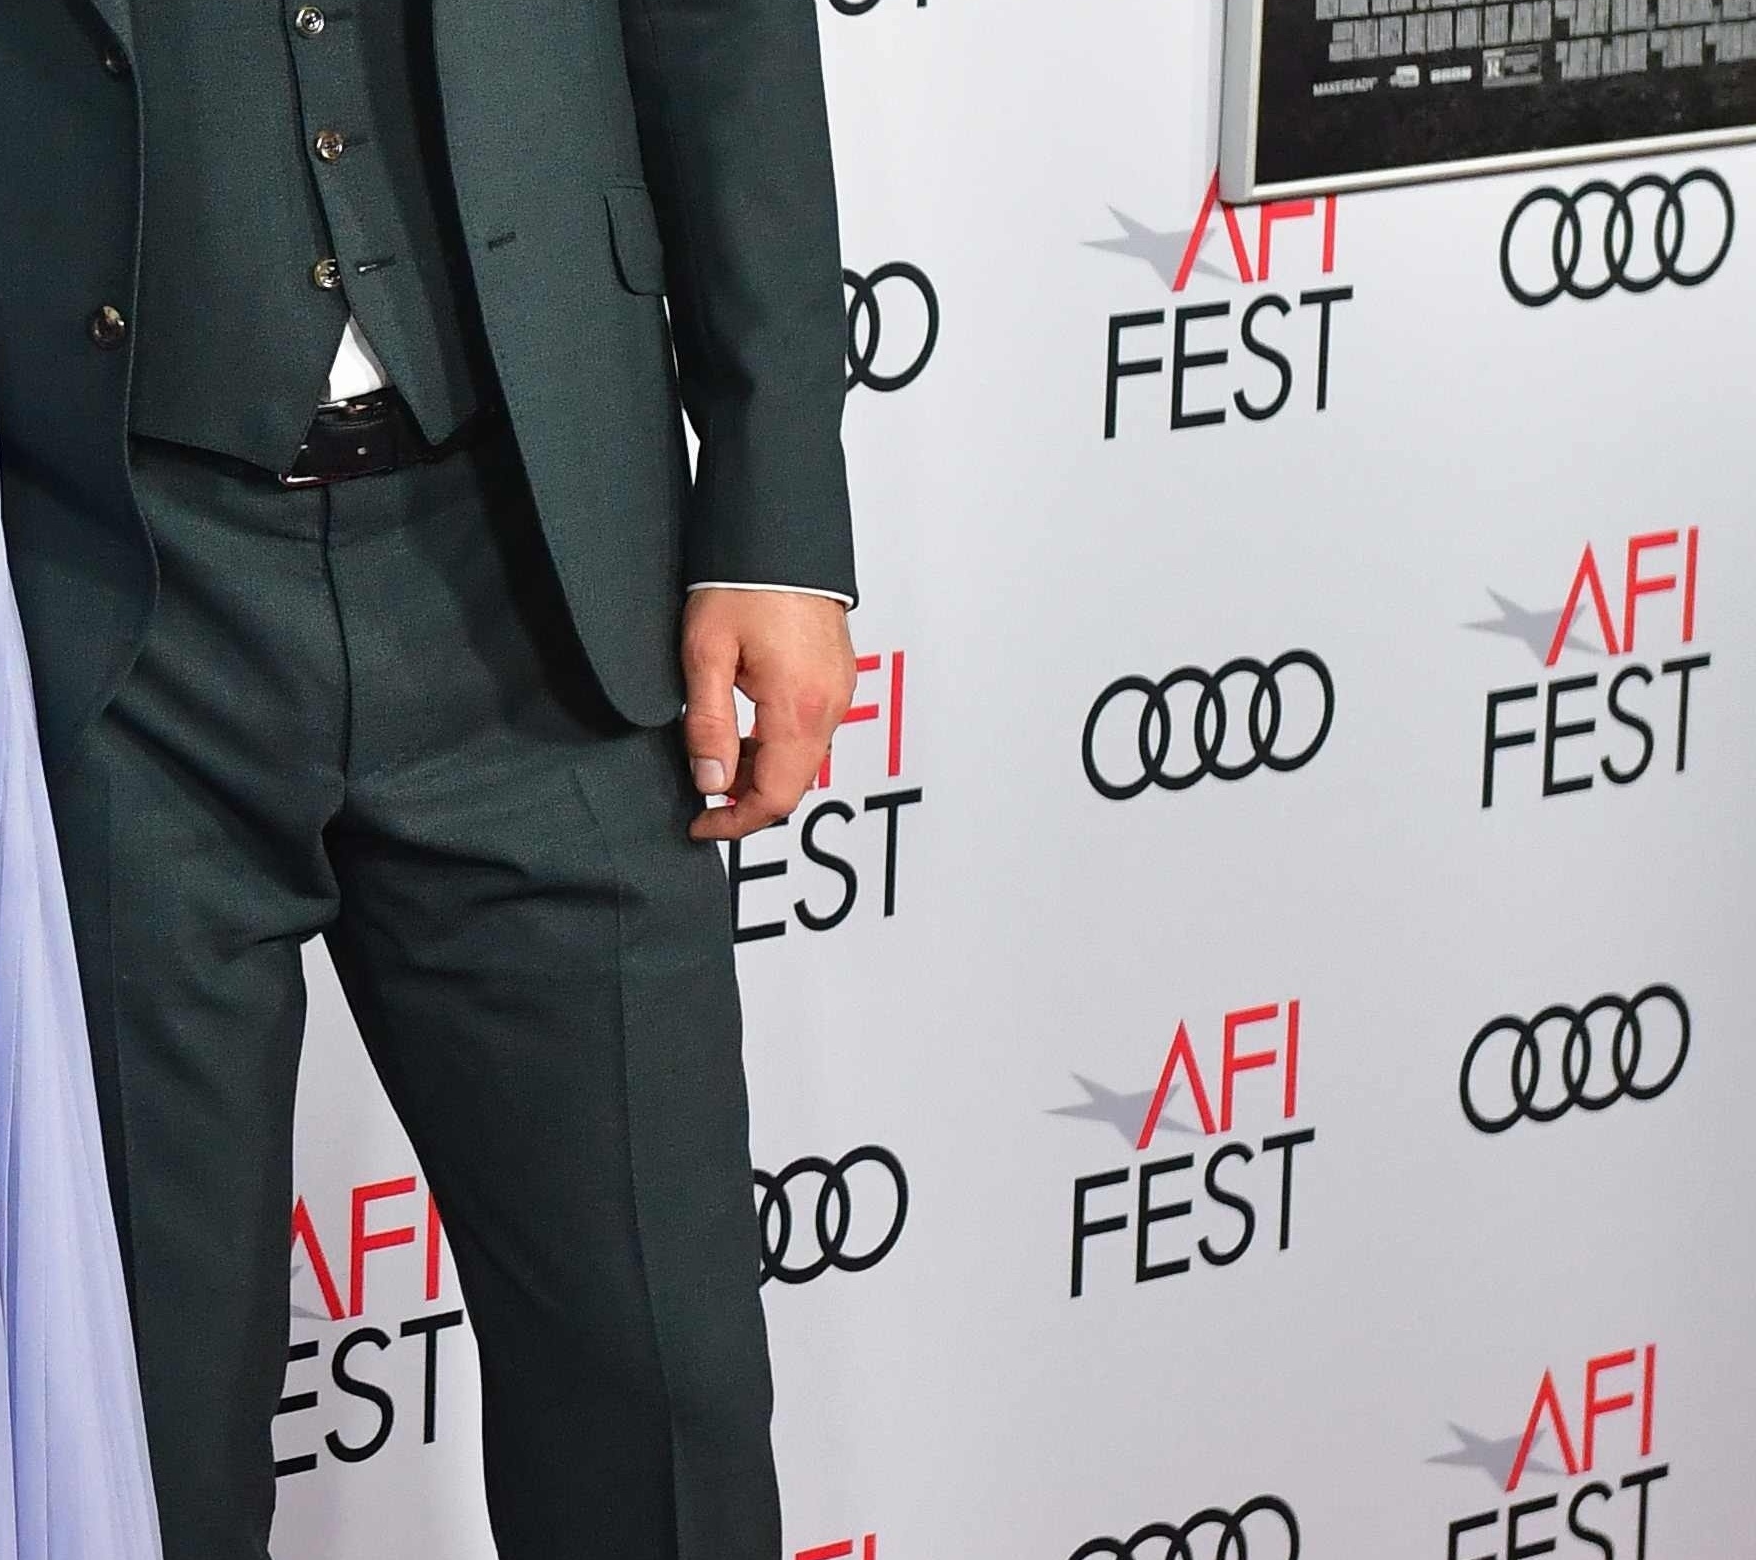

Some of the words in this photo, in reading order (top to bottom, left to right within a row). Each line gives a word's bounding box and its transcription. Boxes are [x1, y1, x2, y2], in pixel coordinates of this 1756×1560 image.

[1104, 286, 1353, 440] FEST
[1546, 527, 1698, 667] AFI
[1482, 655, 1711, 809] FEST
[729, 787, 923, 945] EST
[1136, 1000, 1300, 1150] AFI
[1070, 1127, 1316, 1298] FEST
[275, 1308, 463, 1479] EST
[1506, 1344, 1657, 1492] AFI
